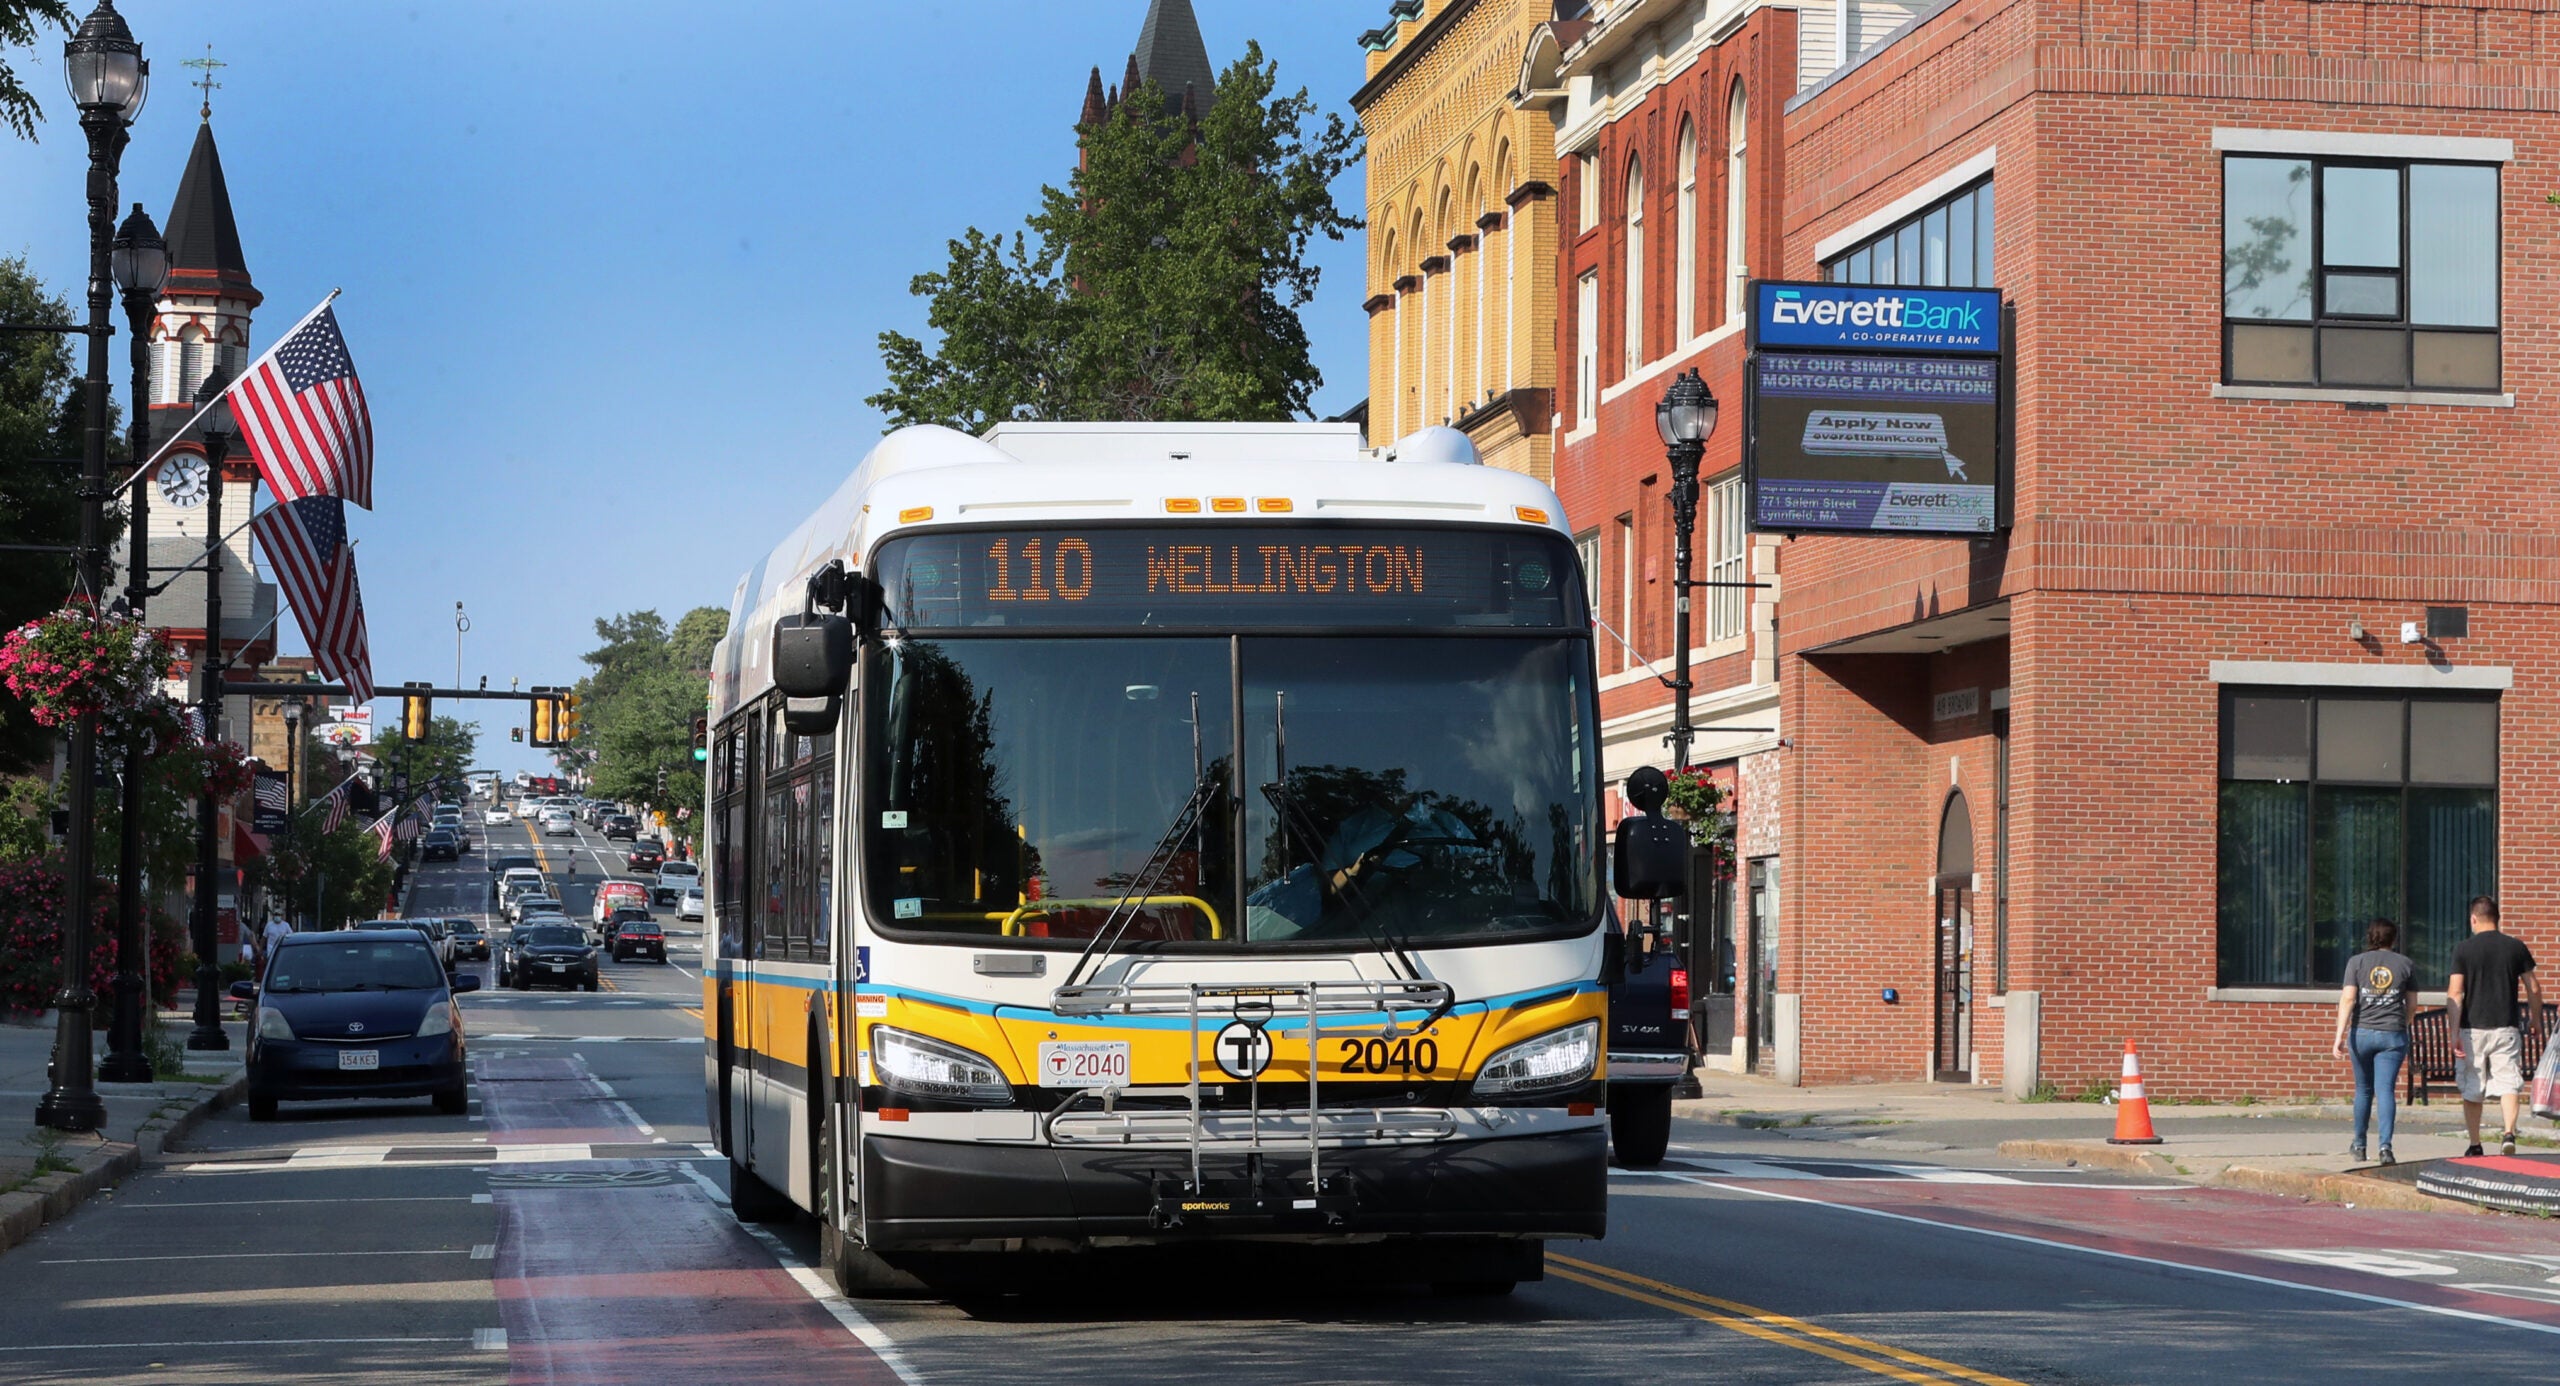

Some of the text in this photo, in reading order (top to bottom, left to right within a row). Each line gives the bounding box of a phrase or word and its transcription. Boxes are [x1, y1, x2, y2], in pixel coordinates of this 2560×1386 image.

[1773, 290, 1982, 330] EverettBank
[1838, 332, 1981, 345] A CO-OPERATIVE BANK
[1766, 356, 1989, 378] TRY OUR SIMPLE ONLINE
[1762, 373, 1993, 395] MORTGAGE APPLICATION!
[1818, 416, 1933, 431] Apply Now
[1812, 432, 1938, 444] everettbank.com
[1761, 495, 1857, 510] 771 Salem Street
[1819, 510, 1839, 521] MA
[988, 537, 1424, 601] 110 WELLINGTON
[342, 711, 369, 720] UNKIN'
[1060, 1043, 1110, 1052] Massachusetts
[341, 1054, 377, 1066] 154 KE3
[1339, 1037, 1438, 1075] 2040
[1051, 1053, 1125, 1076] T 2040
[1181, 1201, 1231, 1211] sportworks
